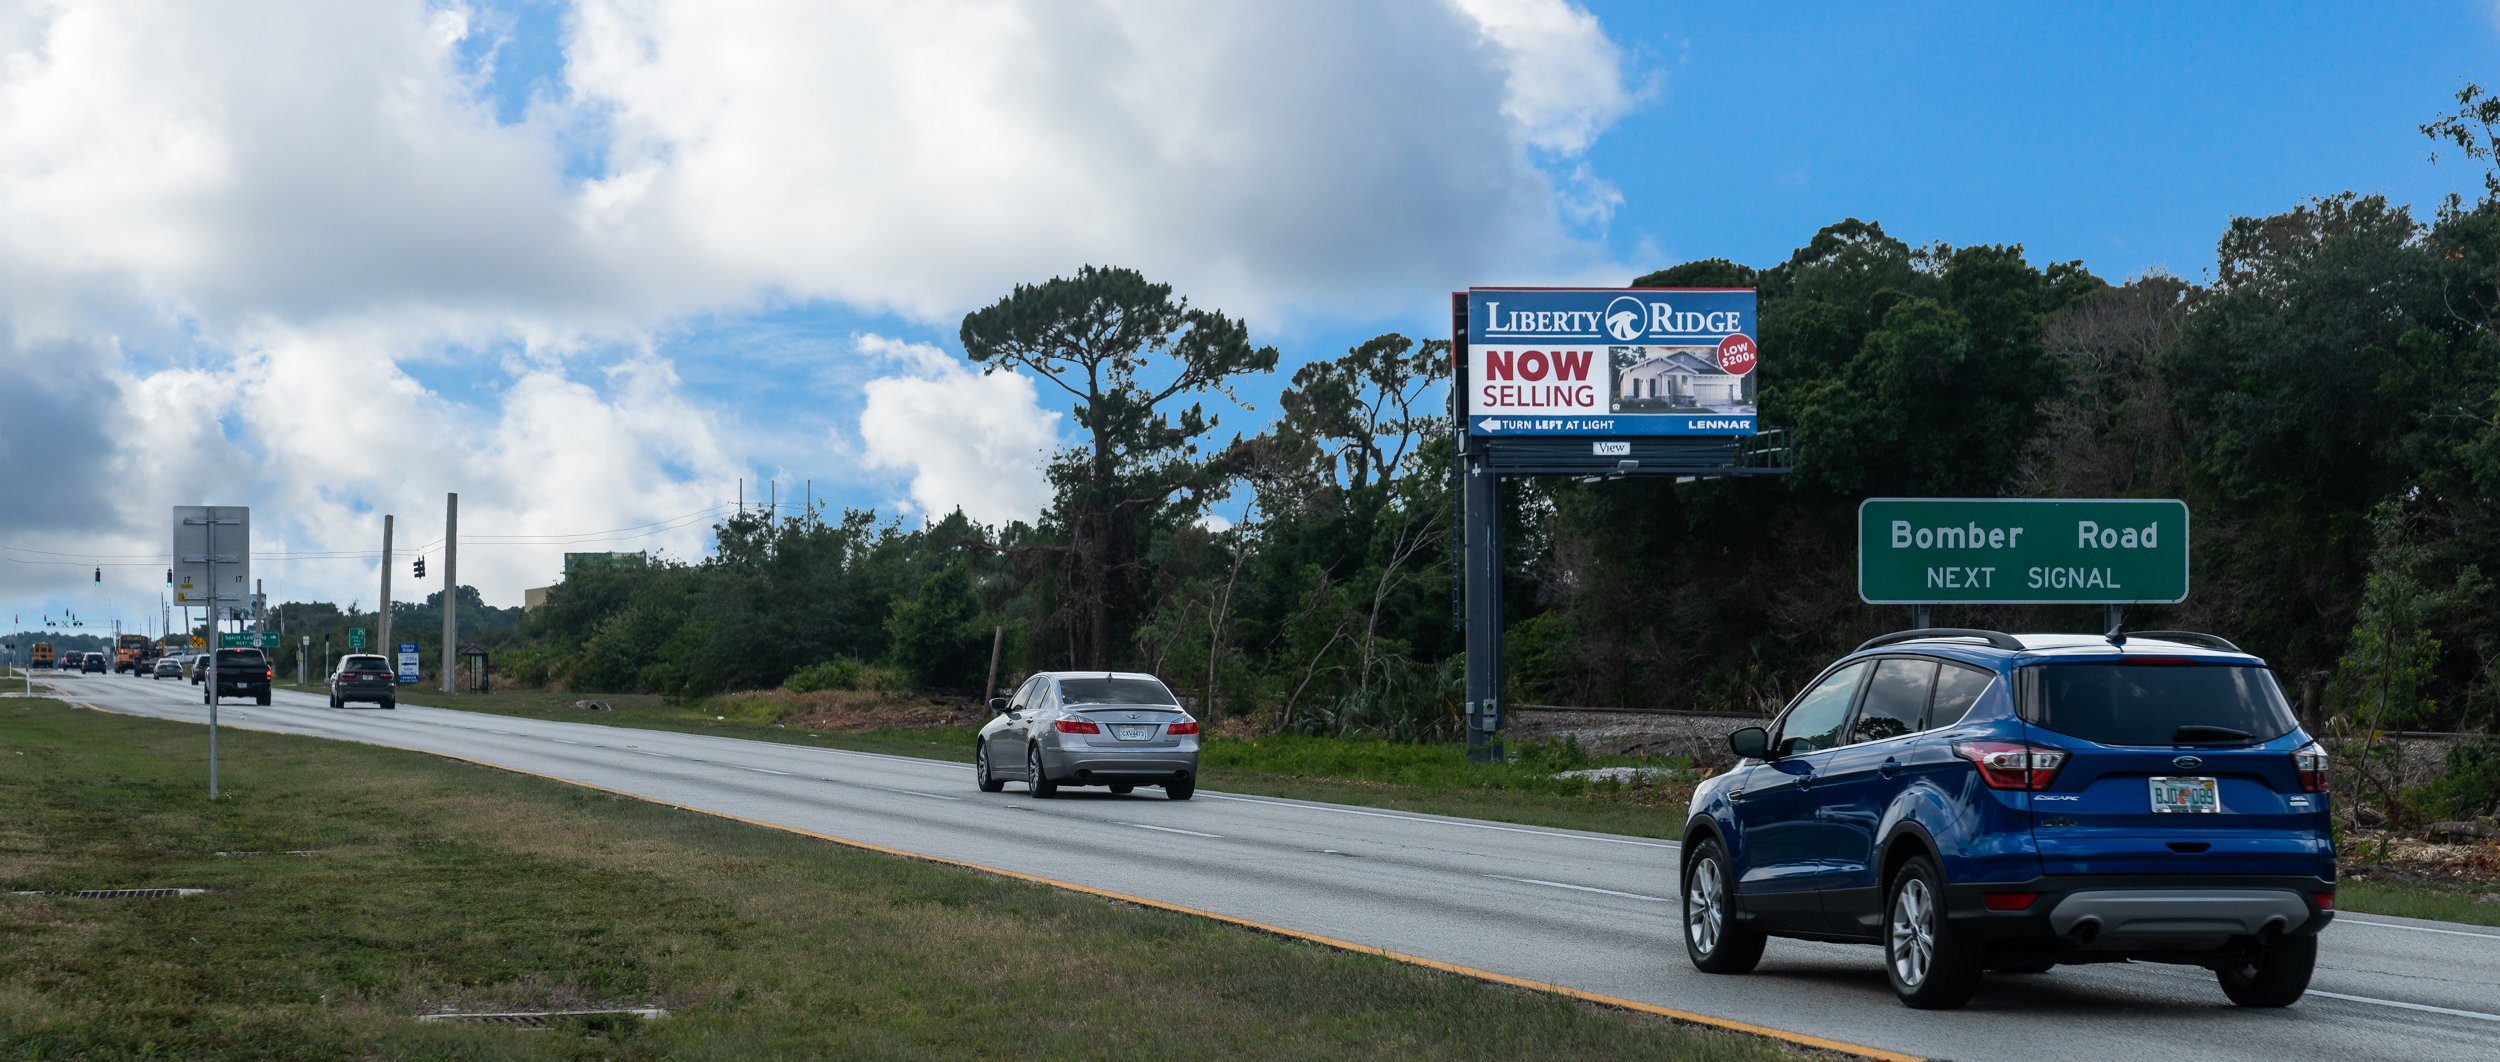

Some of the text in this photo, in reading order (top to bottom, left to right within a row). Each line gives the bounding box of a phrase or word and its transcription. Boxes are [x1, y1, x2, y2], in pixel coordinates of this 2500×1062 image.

[1485, 301, 1742, 334] LIBERTY RIDGE
[1723, 342, 1748, 357] LOW
[1486, 350, 1594, 381] NOW
[1721, 352, 1755, 367] $200s
[1482, 385, 1595, 407] SELLING
[1502, 420, 1615, 430] TURN LEFT AT LIGHT
[1688, 420, 1751, 430] LENNAR
[1598, 442, 1625, 453] View
[1891, 520, 2158, 549] Bomber Road
[183, 576, 191, 584] 17
[234, 575, 243, 583] 17
[1927, 567, 2121, 589] NEXT SIGNAL
